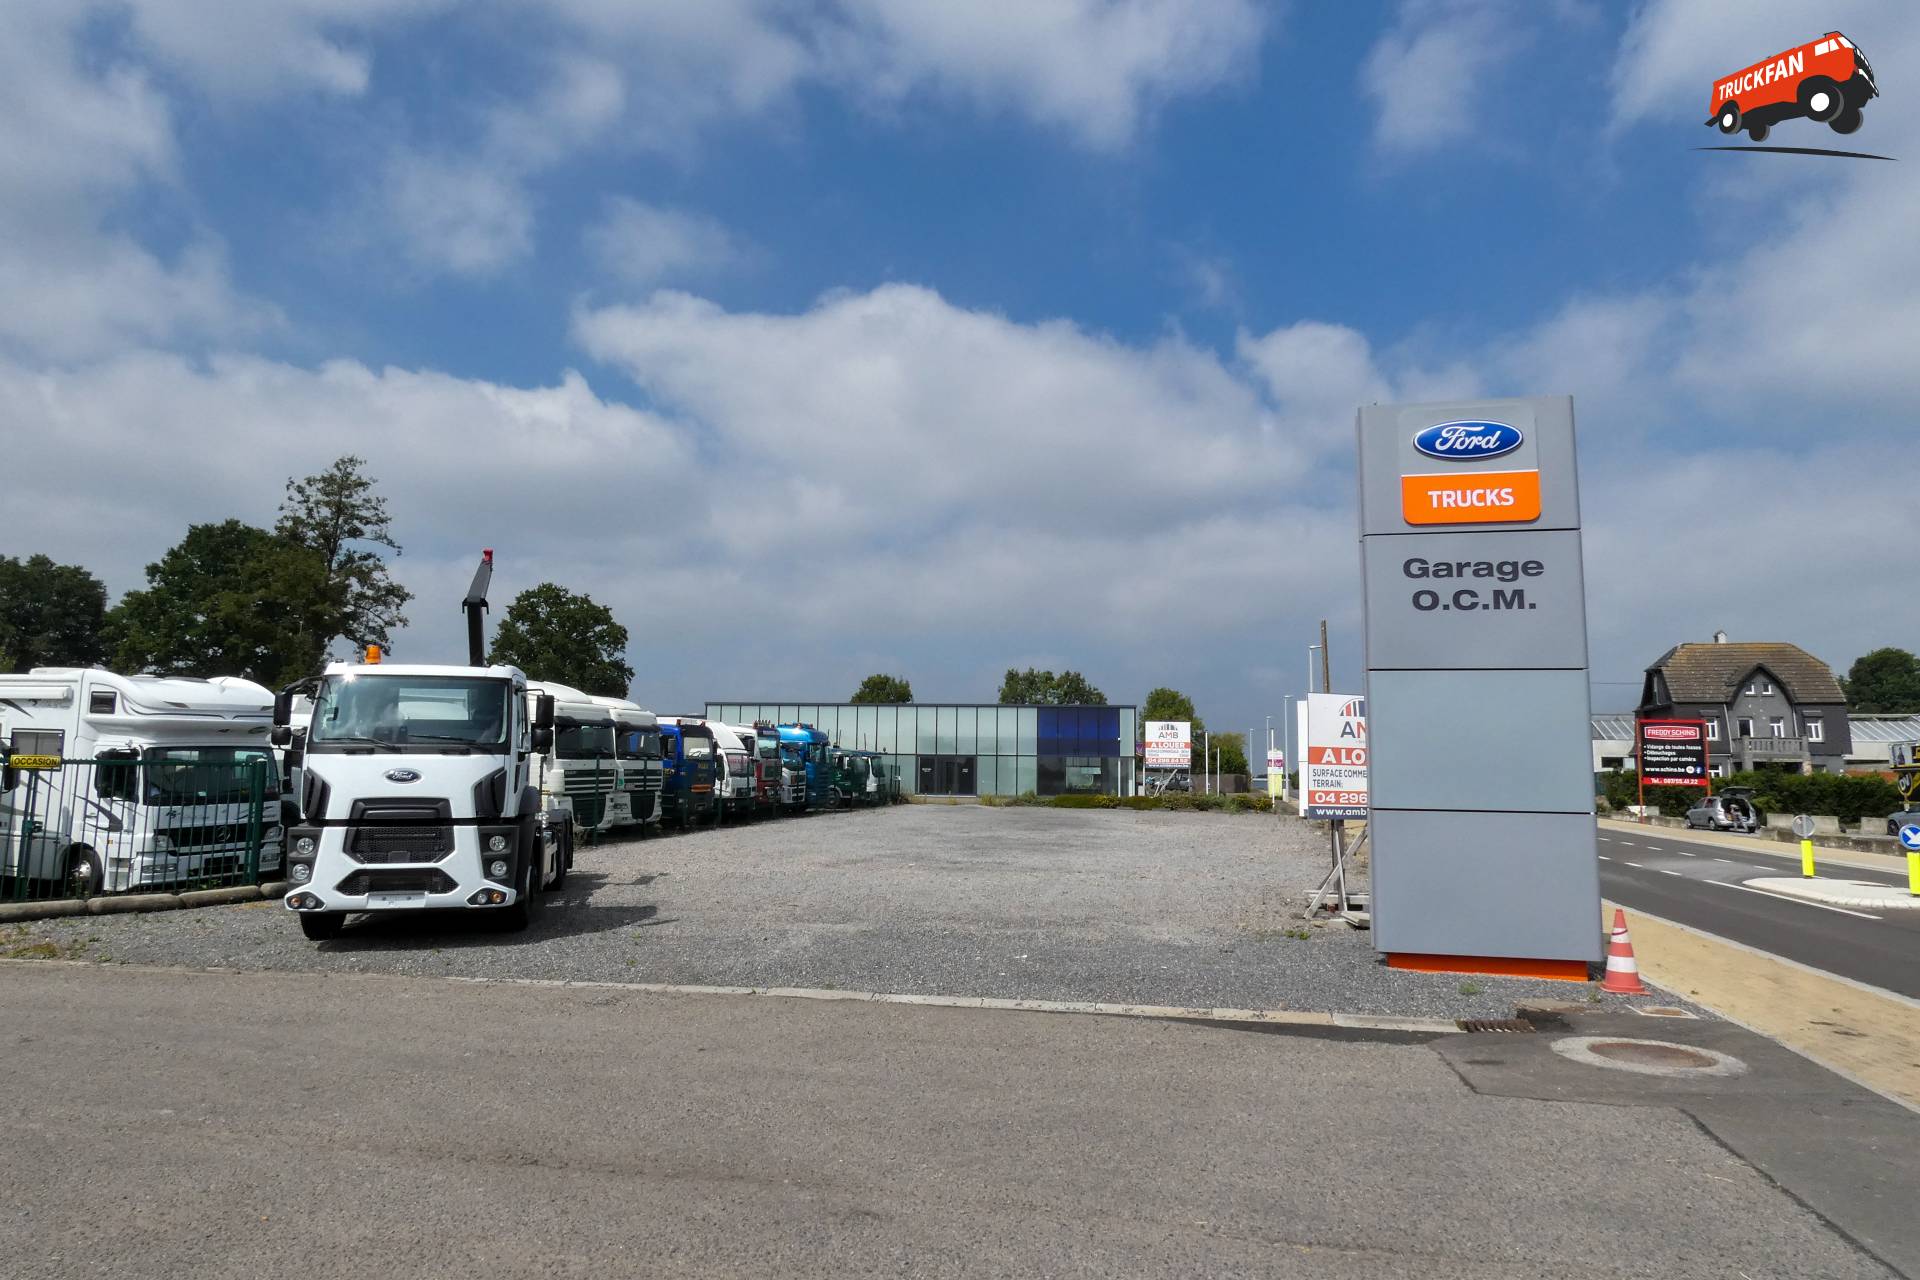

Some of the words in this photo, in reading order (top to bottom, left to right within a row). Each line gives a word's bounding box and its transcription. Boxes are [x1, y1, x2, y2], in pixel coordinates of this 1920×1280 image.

[1435, 426, 1501, 450] Ford
[1428, 488, 1514, 508] TRUCKS
[1403, 558, 1544, 582] Garage
[1412, 589, 1536, 611] O.C.M.
[14, 757, 57, 766] OCCASION
[1321, 749, 1337, 764] A
[1341, 749, 1366, 765] LO
[1312, 769, 1343, 777] SURFACE
[1315, 792, 1336, 804] 04
[1340, 793, 1367, 804] 296
